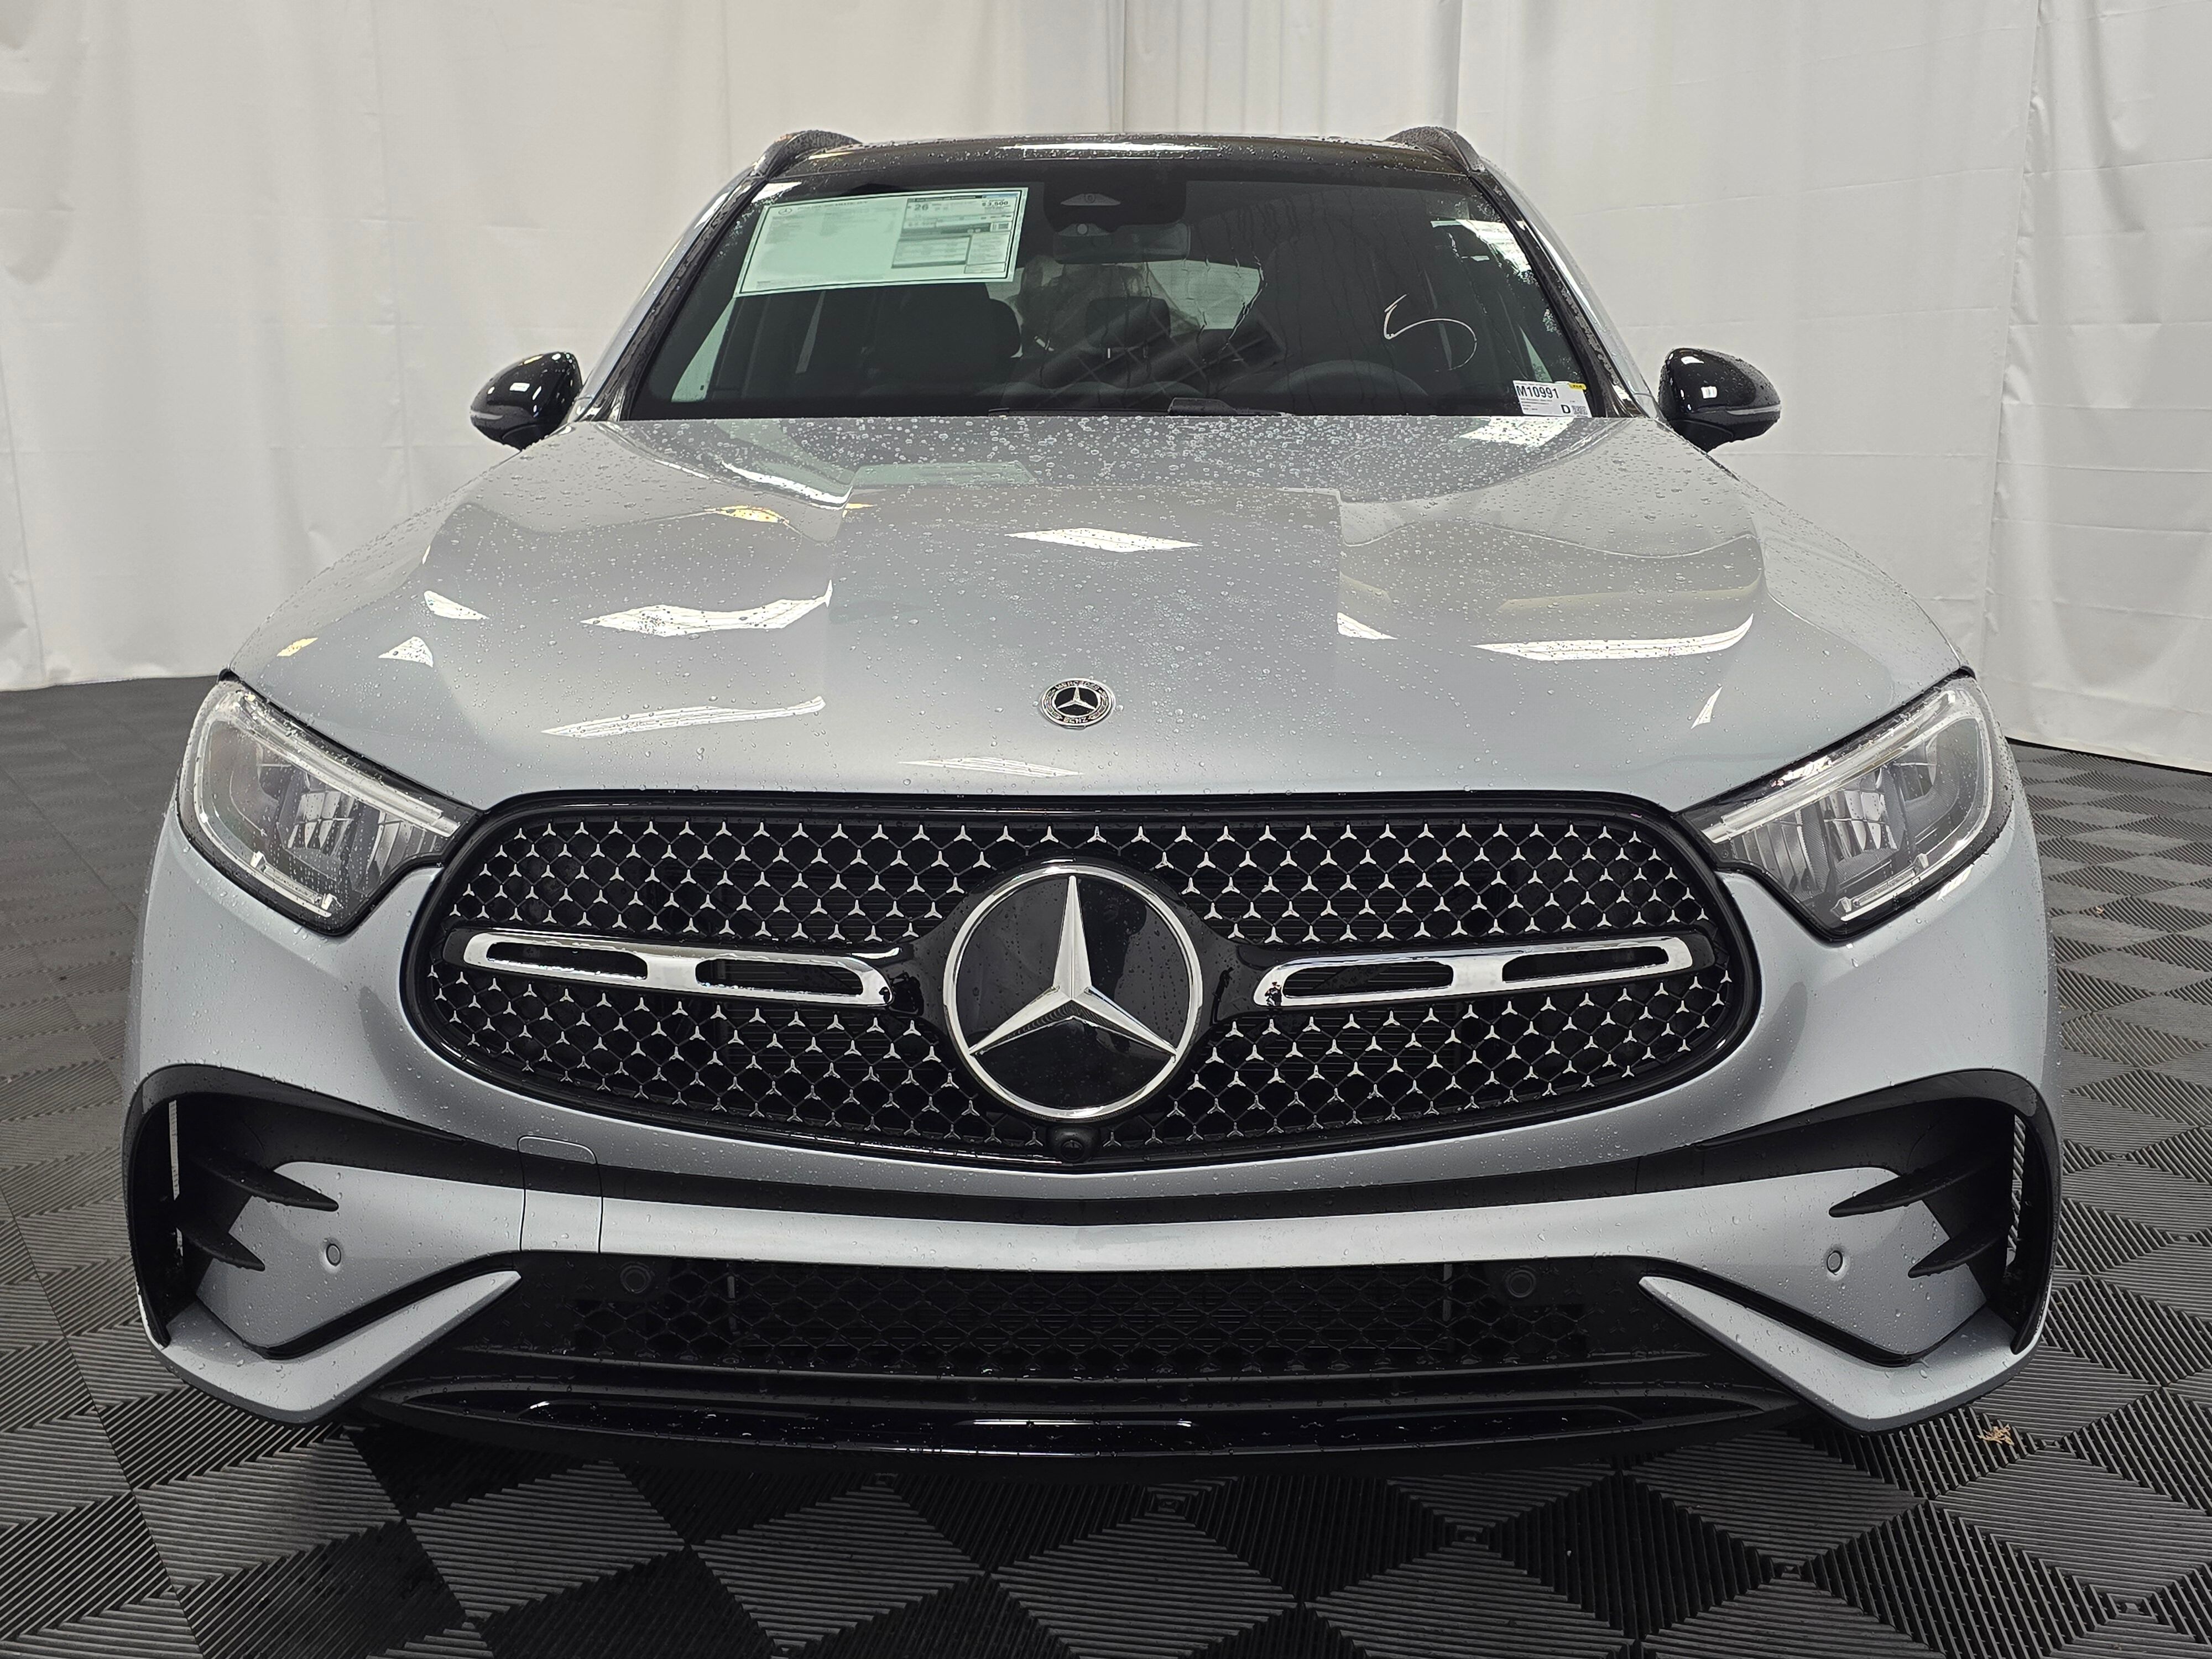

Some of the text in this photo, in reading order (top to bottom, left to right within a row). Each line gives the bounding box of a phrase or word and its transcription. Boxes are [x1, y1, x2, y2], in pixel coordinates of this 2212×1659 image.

[1516, 385, 1559, 399] M10991
[1561, 405, 1571, 414] D
[1055, 681, 1099, 690] MERCEDES
